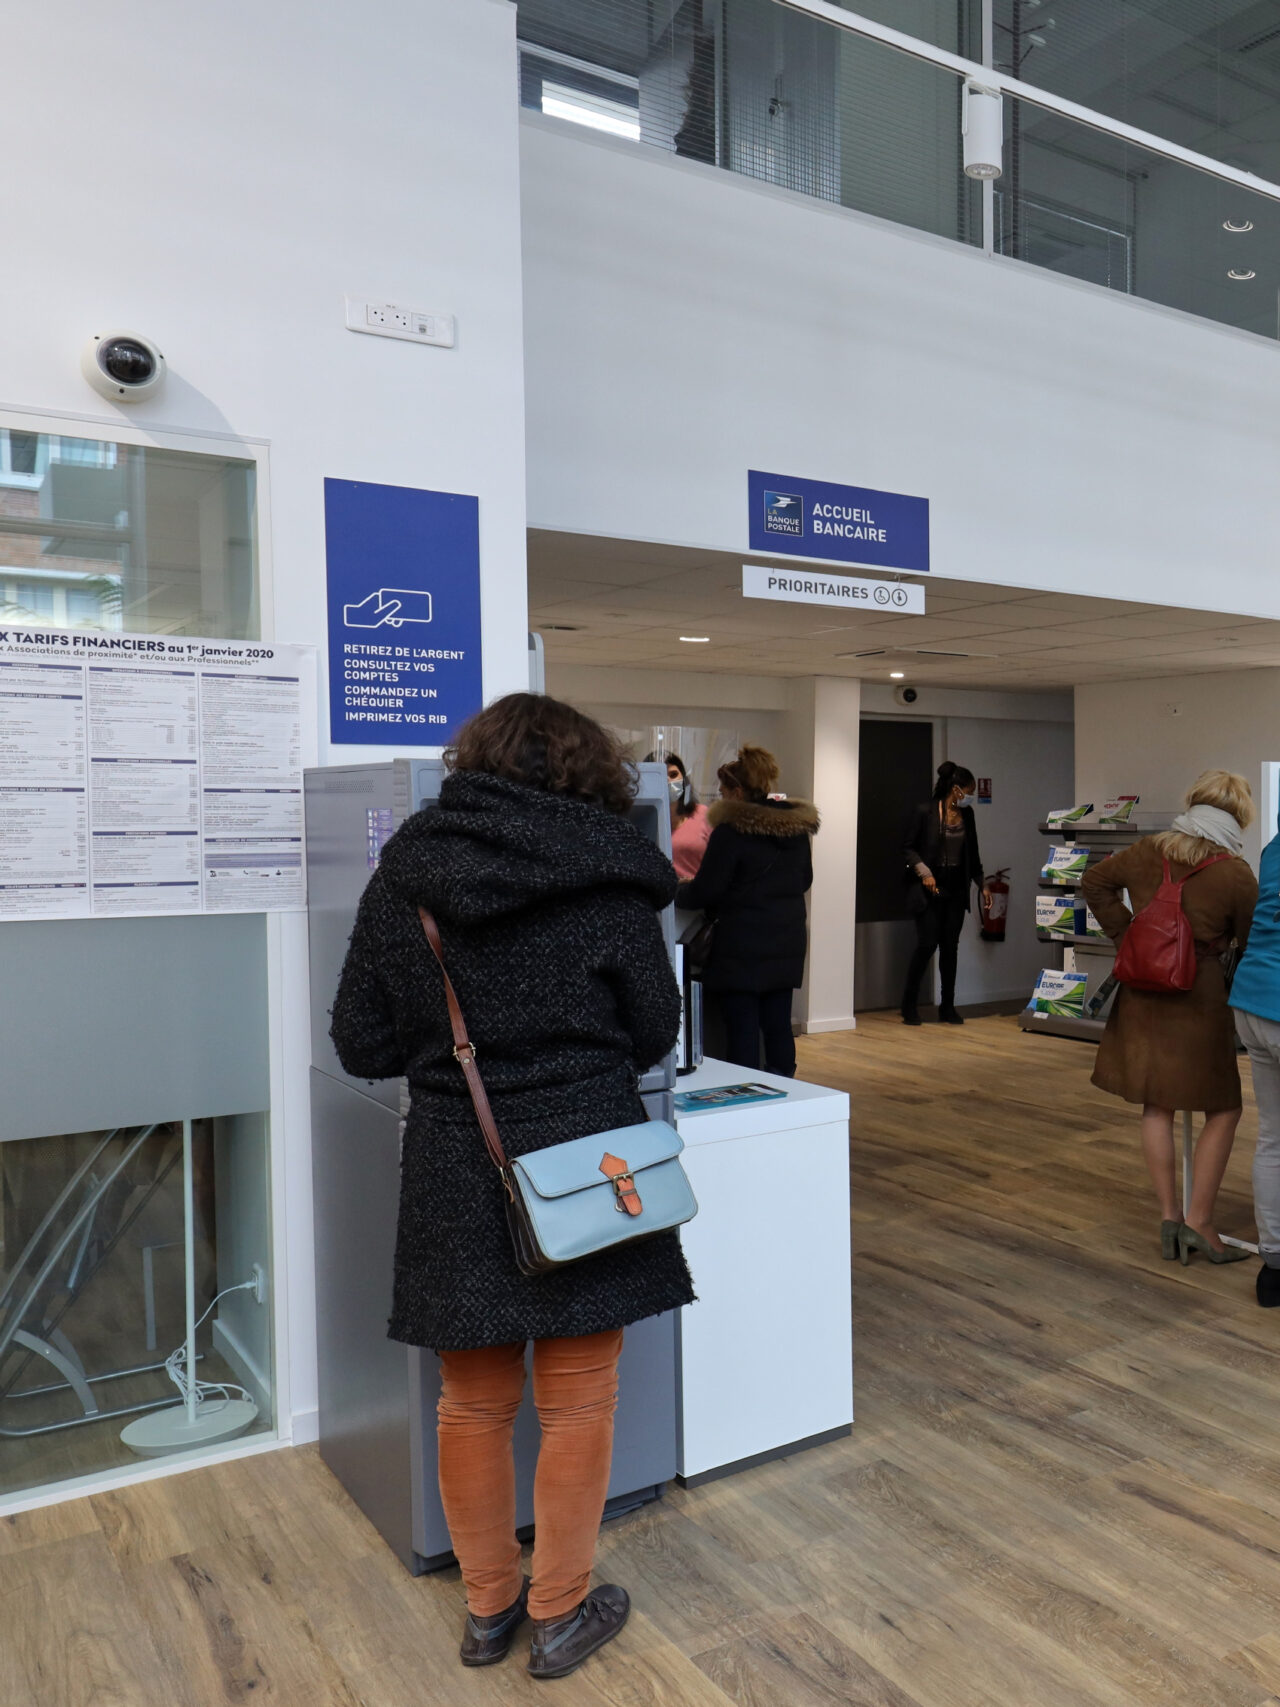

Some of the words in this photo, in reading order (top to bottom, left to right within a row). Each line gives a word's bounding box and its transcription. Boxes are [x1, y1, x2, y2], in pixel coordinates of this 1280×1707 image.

[812, 502, 874, 524] ACCUEIL
[768, 515, 800, 526] BANQUE
[768, 523, 800, 533] POSTALE
[814, 520, 887, 542] BANCAIRE
[768, 576, 868, 600] PRIORITAIRES
[12, 632, 69, 646] TARIFS
[72, 636, 166, 652] FINANCIERS
[168, 645, 184, 654] au
[200, 645, 244, 657] janvier
[246, 648, 274, 659] 2020
[344, 644, 393, 657] RETIREZ
[395, 646, 410, 658] DE
[413, 648, 465, 660] L'ARGENT
[7, 645, 71, 656] Associations
[73, 648, 86, 656] de
[140, 652, 166, 662] et/ou
[344, 659, 411, 672] CONSULTEZ
[413, 662, 435, 673] VOS
[344, 670, 400, 682] COMPTES
[345, 686, 418, 698] COMMANDEZ
[421, 688, 438, 698] UN
[345, 697, 404, 708] CHÉQUIER
[345, 712, 402, 723] IMPRIMEZ
[404, 713, 426, 724] VOS
[428, 714, 448, 724] RIB
